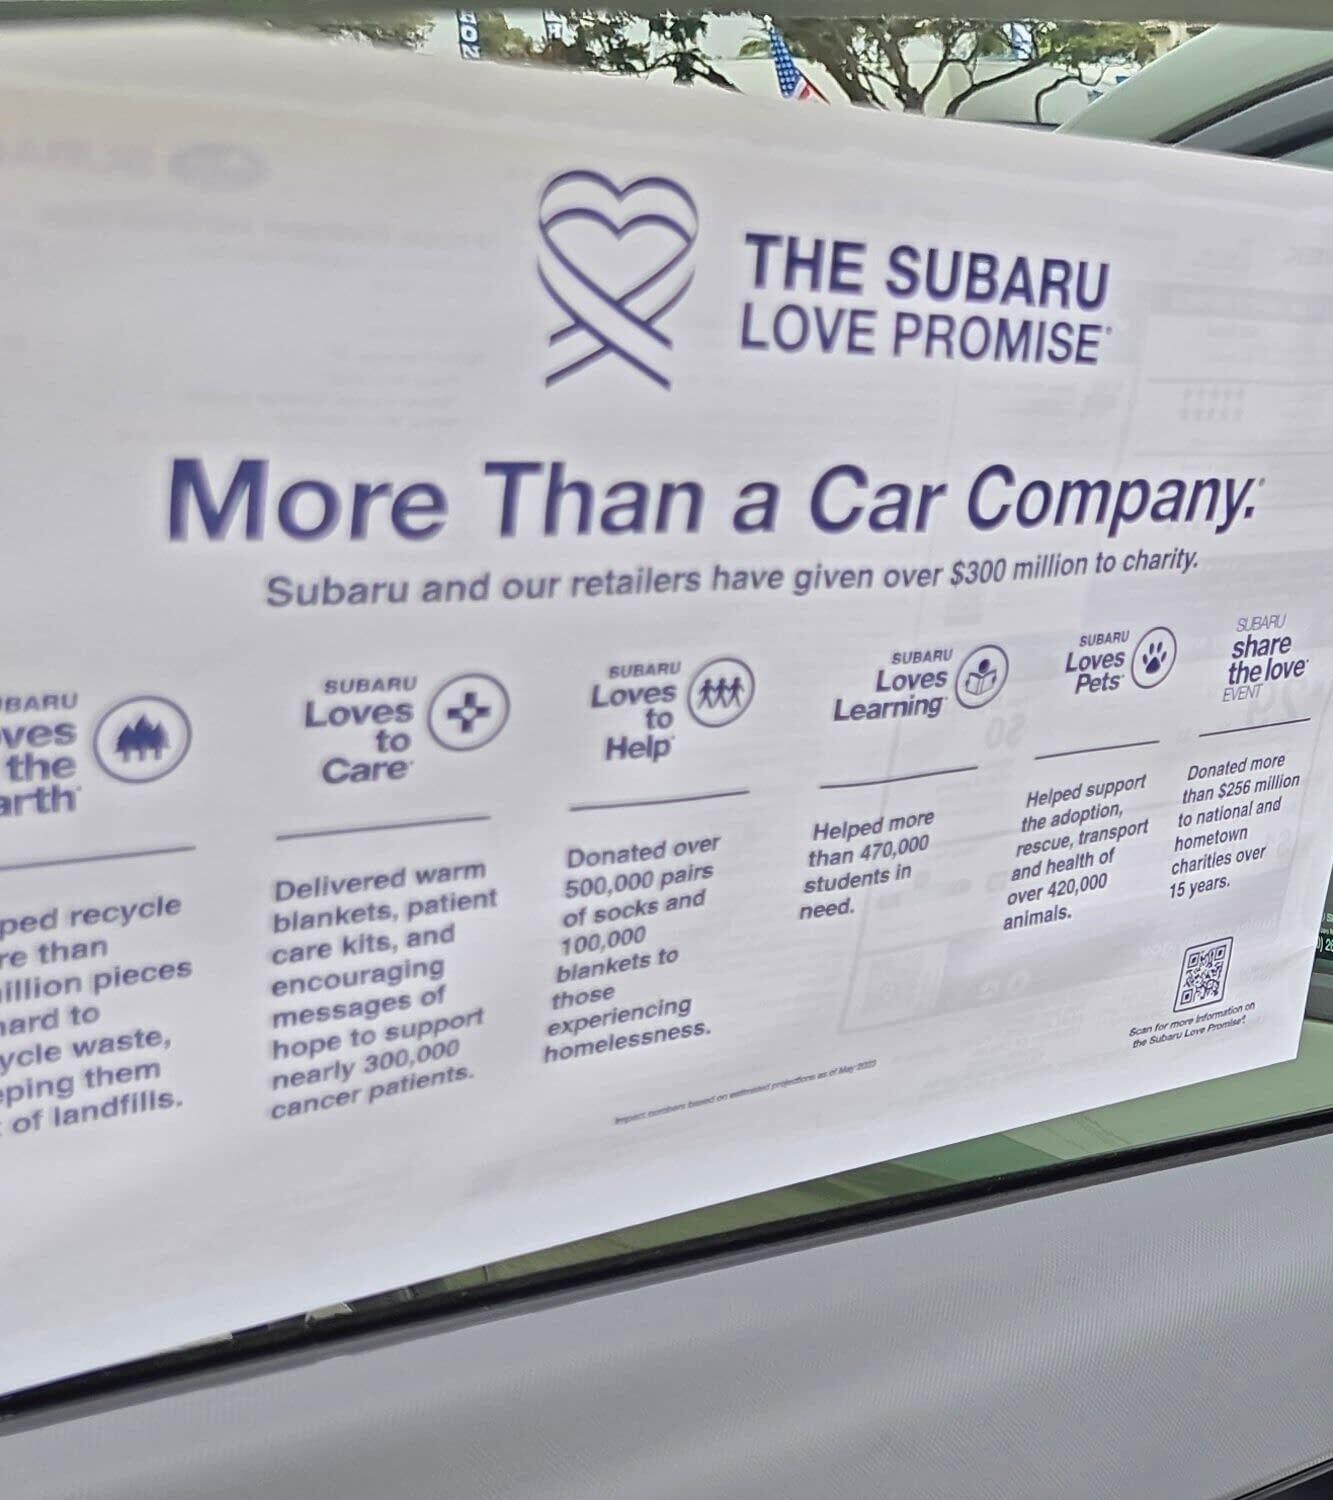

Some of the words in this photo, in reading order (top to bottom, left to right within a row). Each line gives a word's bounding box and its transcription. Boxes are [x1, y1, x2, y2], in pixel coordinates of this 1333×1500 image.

[744, 232, 867, 295] THE
[885, 244, 1110, 311] SUBARU
[740, 301, 877, 356] LOVE
[893, 311, 1103, 365] PROMISE
[169, 457, 448, 541] More
[484, 460, 704, 538] Than
[732, 481, 780, 534] a
[810, 463, 948, 534] Car
[967, 463, 1256, 539] Company.
[266, 575, 409, 608] Subaru
[421, 571, 491, 603] and
[501, 576, 562, 601] our
[570, 566, 702, 598] retailers
[711, 563, 785, 591] have
[792, 562, 874, 597] given
[883, 563, 945, 589] over
[949, 557, 1007, 588] $300
[1012, 552, 1089, 581] million
[1095, 551, 1117, 574] to
[1122, 547, 1198, 575] charity.
[1235, 612, 1288, 633] SUBARU
[1078, 629, 1130, 648] SUBARU
[1231, 633, 1292, 660] share
[607, 660, 682, 680] SUBARU
[891, 648, 954, 665] SUBARU
[1064, 651, 1126, 674] Loves
[323, 675, 418, 695] SUBARU
[590, 683, 677, 709] Loves
[875, 669, 949, 693] Loves
[1074, 671, 1121, 695] Pets
[1222, 683, 1264, 703] EVENT
[0, 692, 78, 712] BARU
[304, 700, 414, 729] Loves
[833, 694, 945, 722] Learning
[644, 707, 674, 731] to
[0, 722, 77, 749] ves
[374, 728, 412, 754] to
[605, 734, 671, 763] Help
[4, 751, 76, 783] the
[321, 756, 409, 785] Care
[1186, 756, 1249, 782] Donated
[1249, 754, 1286, 772] more
[1025, 782, 1084, 809] Helped
[1085, 773, 1147, 799] support
[1182, 787, 1215, 805] than
[1217, 779, 1252, 799] $256
[1254, 773, 1301, 793] million
[812, 815, 885, 843] Helped
[888, 811, 935, 832] more
[1020, 815, 1047, 833] the
[1049, 803, 1124, 828] adoption,
[1177, 812, 1193, 828] to
[1195, 800, 1254, 825] national
[1255, 795, 1283, 815] and
[566, 839, 667, 869] Donated
[672, 836, 722, 857] over
[808, 849, 854, 868] than
[859, 833, 930, 861] 470,000
[1015, 835, 1074, 858] rescue,
[1078, 818, 1149, 846] transport
[1174, 827, 1248, 853] hometown
[1010, 859, 1043, 882] and
[1045, 851, 1095, 875] health
[1098, 846, 1116, 865] of
[1171, 851, 1232, 876] charities
[1235, 846, 1267, 863] over
[273, 866, 407, 903] Delivered
[414, 862, 487, 885] warm
[564, 869, 655, 900] 500,000
[659, 863, 715, 891] pairs
[803, 868, 891, 894] students
[895, 863, 912, 881] in
[1007, 887, 1044, 906] over
[1047, 872, 1108, 898] 420,000
[1169, 880, 1186, 899] 15
[1188, 876, 1231, 900] years.
[69, 895, 182, 928] recycle
[271, 902, 399, 935] blankets,
[405, 887, 498, 923] patient
[561, 906, 588, 929] of
[592, 898, 660, 924] socks
[665, 887, 707, 912] and
[799, 896, 855, 921] need.
[1002, 904, 1072, 931] animals.
[36, 939, 108, 965] than
[270, 942, 333, 966] care
[341, 932, 398, 956] kits,
[405, 922, 456, 949] and
[561, 924, 647, 956] 100,000
[270, 959, 447, 997] encouraging
[555, 953, 652, 984] blankets
[657, 948, 679, 966] to
[0, 976, 82, 1003] illion
[93, 961, 193, 996] pieces
[271, 994, 412, 1029] messages
[419, 983, 447, 1007] of
[551, 986, 616, 1011] those
[68, 1005, 100, 1026] to
[546, 998, 693, 1043] experiencing
[1128, 1026, 1153, 1037] Scan
[1154, 1022, 1170, 1033] for
[1169, 1017, 1195, 1029] more
[1244, 1001, 1256, 1012] on
[71, 1028, 171, 1059] waste,
[271, 1035, 342, 1061] hope
[349, 1028, 377, 1048] to
[384, 1006, 485, 1042] support
[543, 1022, 712, 1064] homelessness.
[1132, 1038, 1148, 1049] the
[1148, 1031, 1183, 1045] Subaru
[1183, 1026, 1206, 1038] Love
[83, 1061, 161, 1089] them
[271, 1059, 356, 1091] nearly
[363, 1038, 461, 1074] 300,000
[270, 1087, 362, 1120] cancer
[367, 1066, 474, 1105] patients.
[11, 1108, 43, 1135] of
[53, 1089, 183, 1128] landfills.
